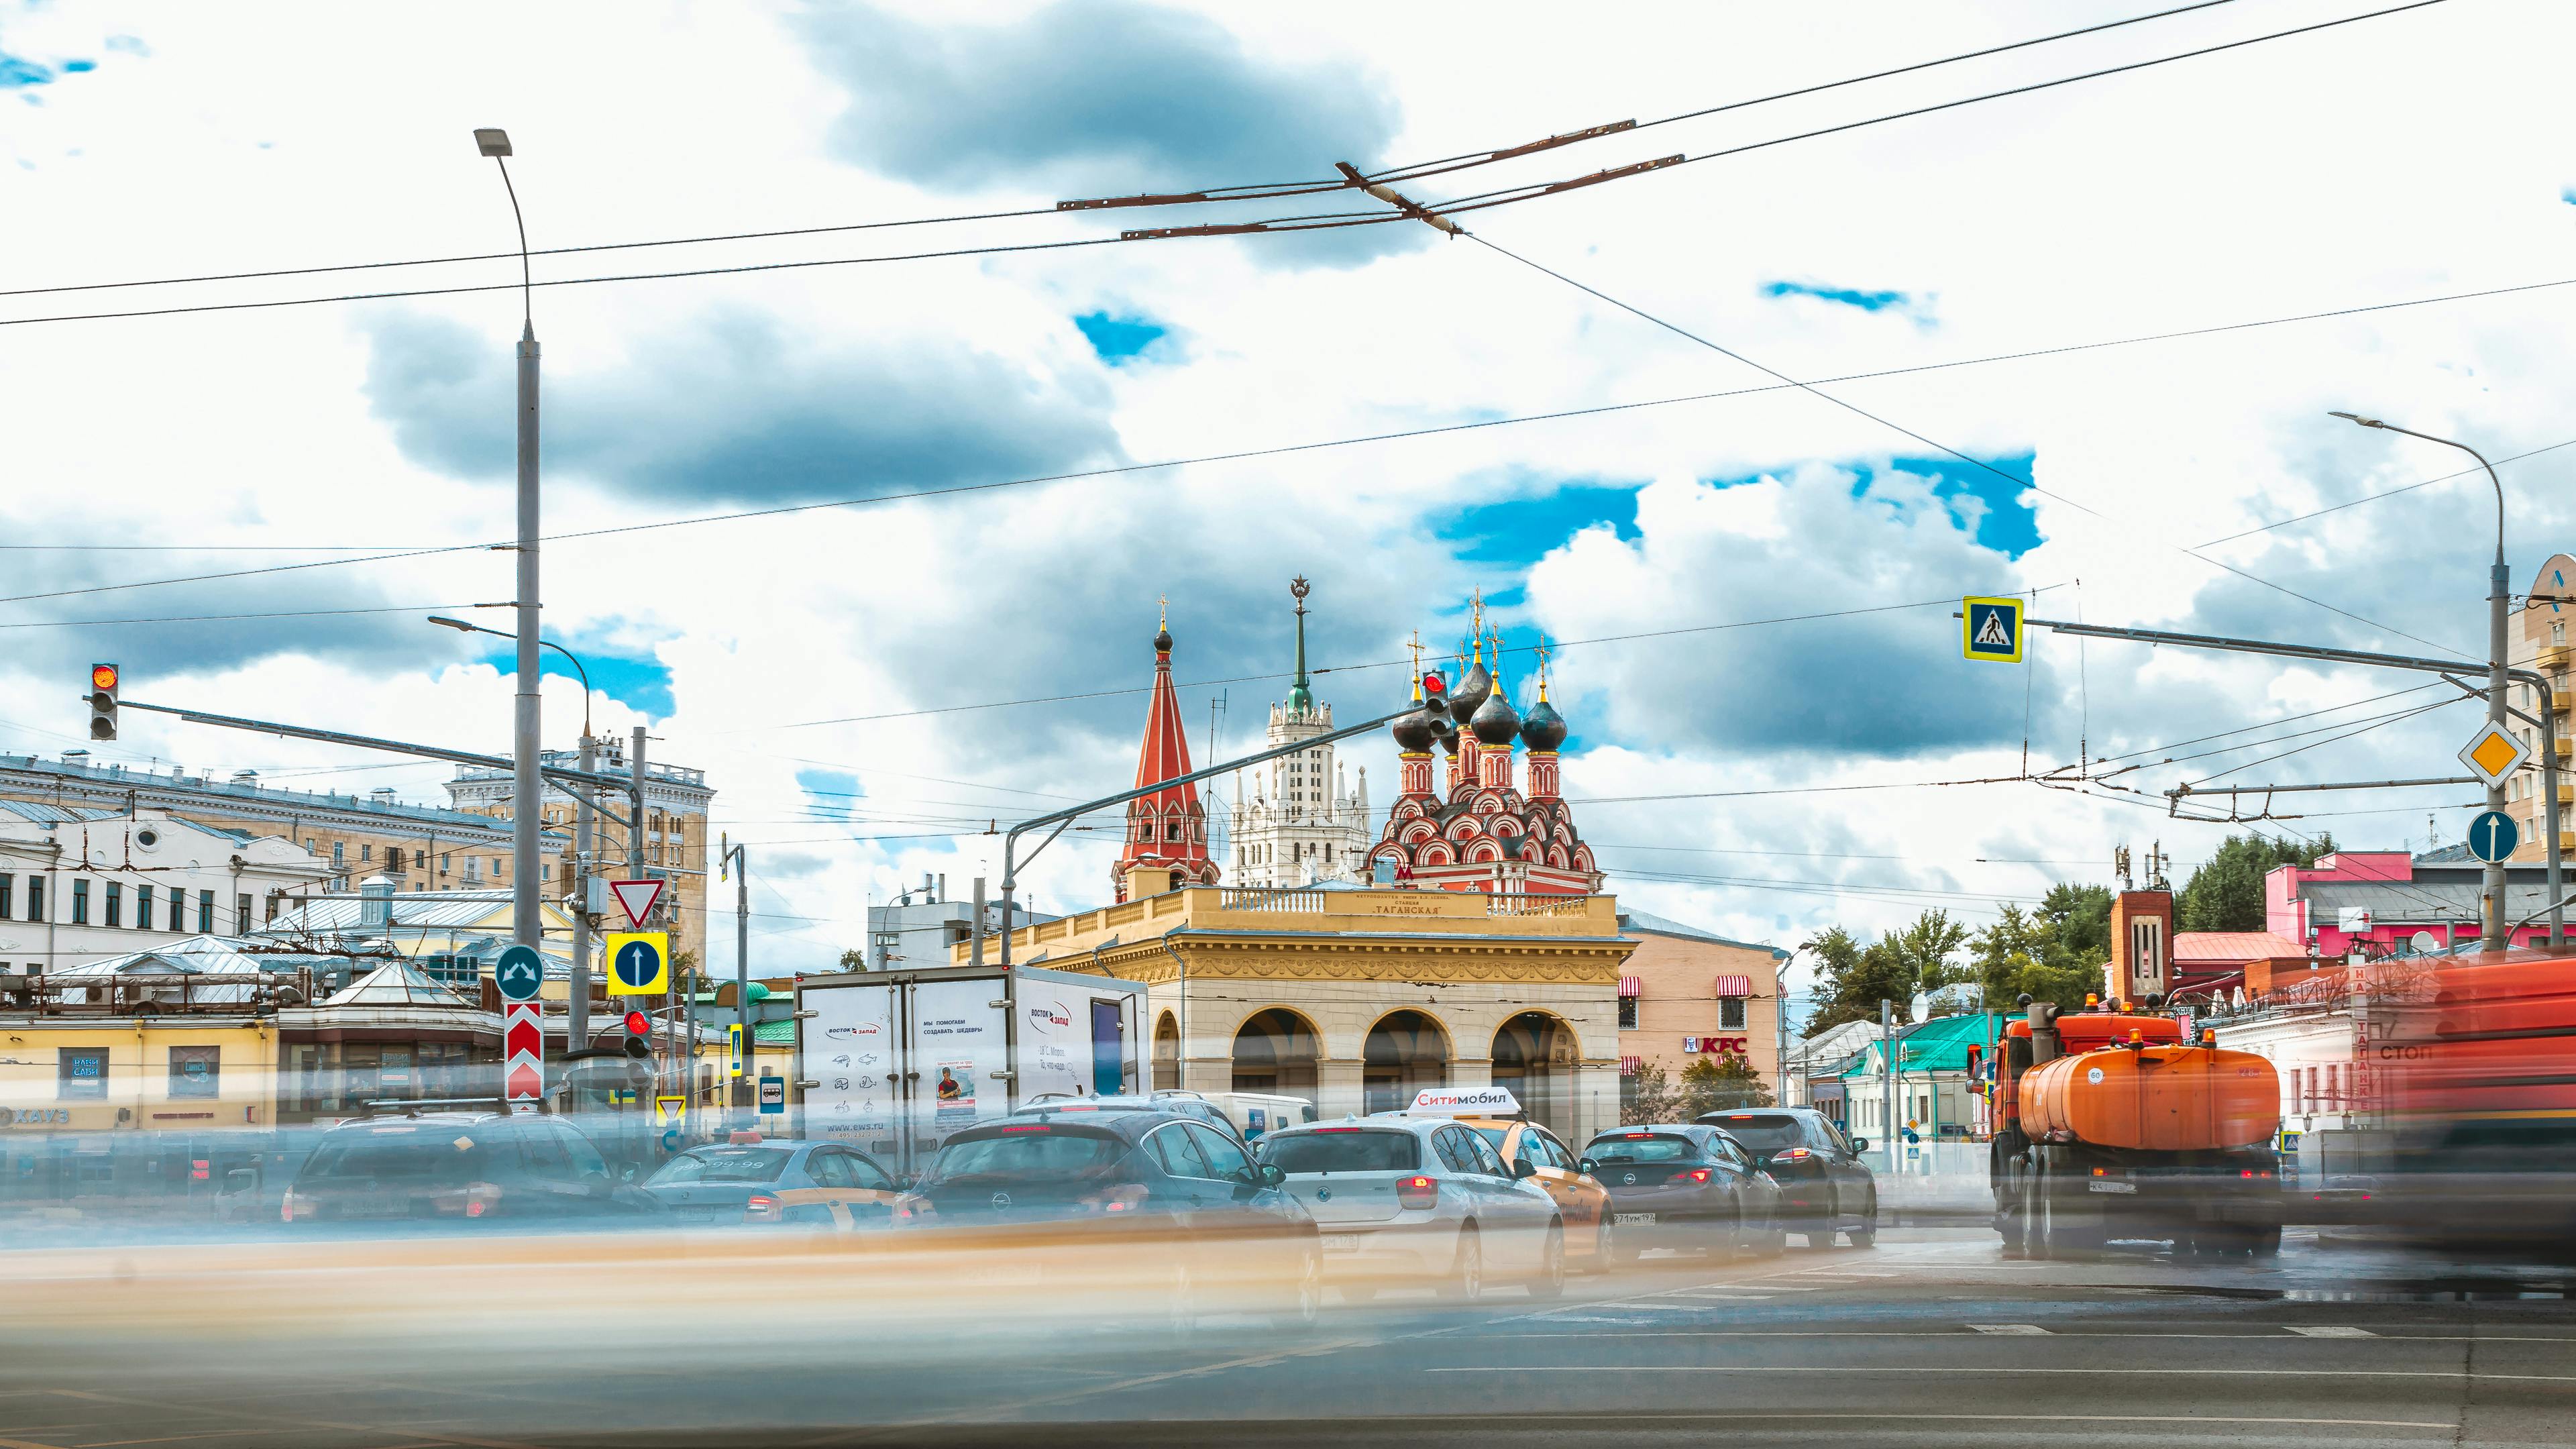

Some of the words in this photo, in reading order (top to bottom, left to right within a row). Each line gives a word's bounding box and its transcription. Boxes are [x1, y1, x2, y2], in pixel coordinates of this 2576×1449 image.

[2355, 969, 2365, 991] НА
[1031, 1008, 1049, 1018] ВОСТОК
[1054, 1016, 1069, 1027] ЗАПАД
[1701, 1037, 1747, 1053] KFC
[2380, 1046, 2432, 1059] СТОП
[74, 1068, 98, 1076] САБИ
[185, 1062, 206, 1071] Lunch
[2357, 1022, 2368, 1110] ТАГАНКЕ
[1417, 1092, 1506, 1106] Ситимобил
[13, 1108, 69, 1123] ХАУЗ
[826, 1122, 883, 1132] www.ews.ru
